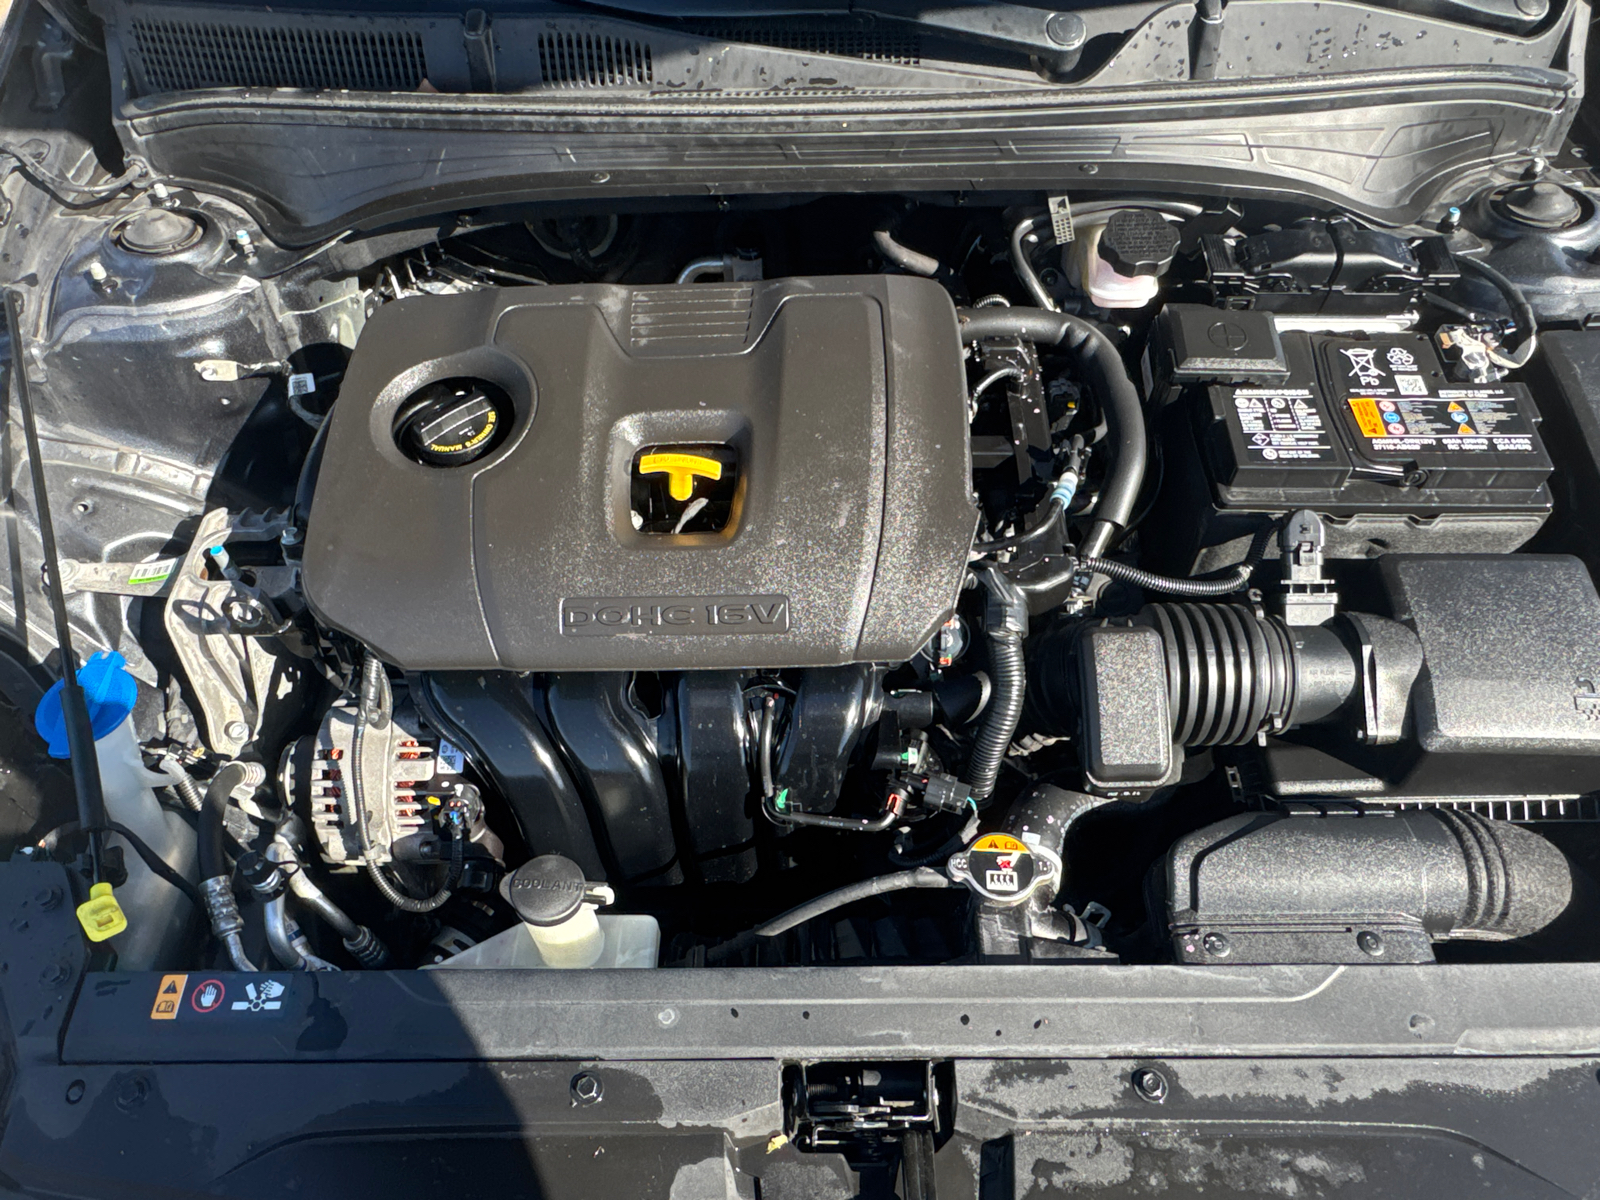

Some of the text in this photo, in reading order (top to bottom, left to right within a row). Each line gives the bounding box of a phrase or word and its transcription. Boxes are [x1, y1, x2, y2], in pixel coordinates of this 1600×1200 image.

[1359, 376, 1380, 386] Pb
[487, 411, 497, 424] SEE
[465, 423, 494, 448] OWNER'S
[430, 443, 463, 453] MANUAL
[563, 602, 786, 628] DOHC 16V
[950, 858, 967, 868] HCC
[512, 878, 584, 893] COOLANT
